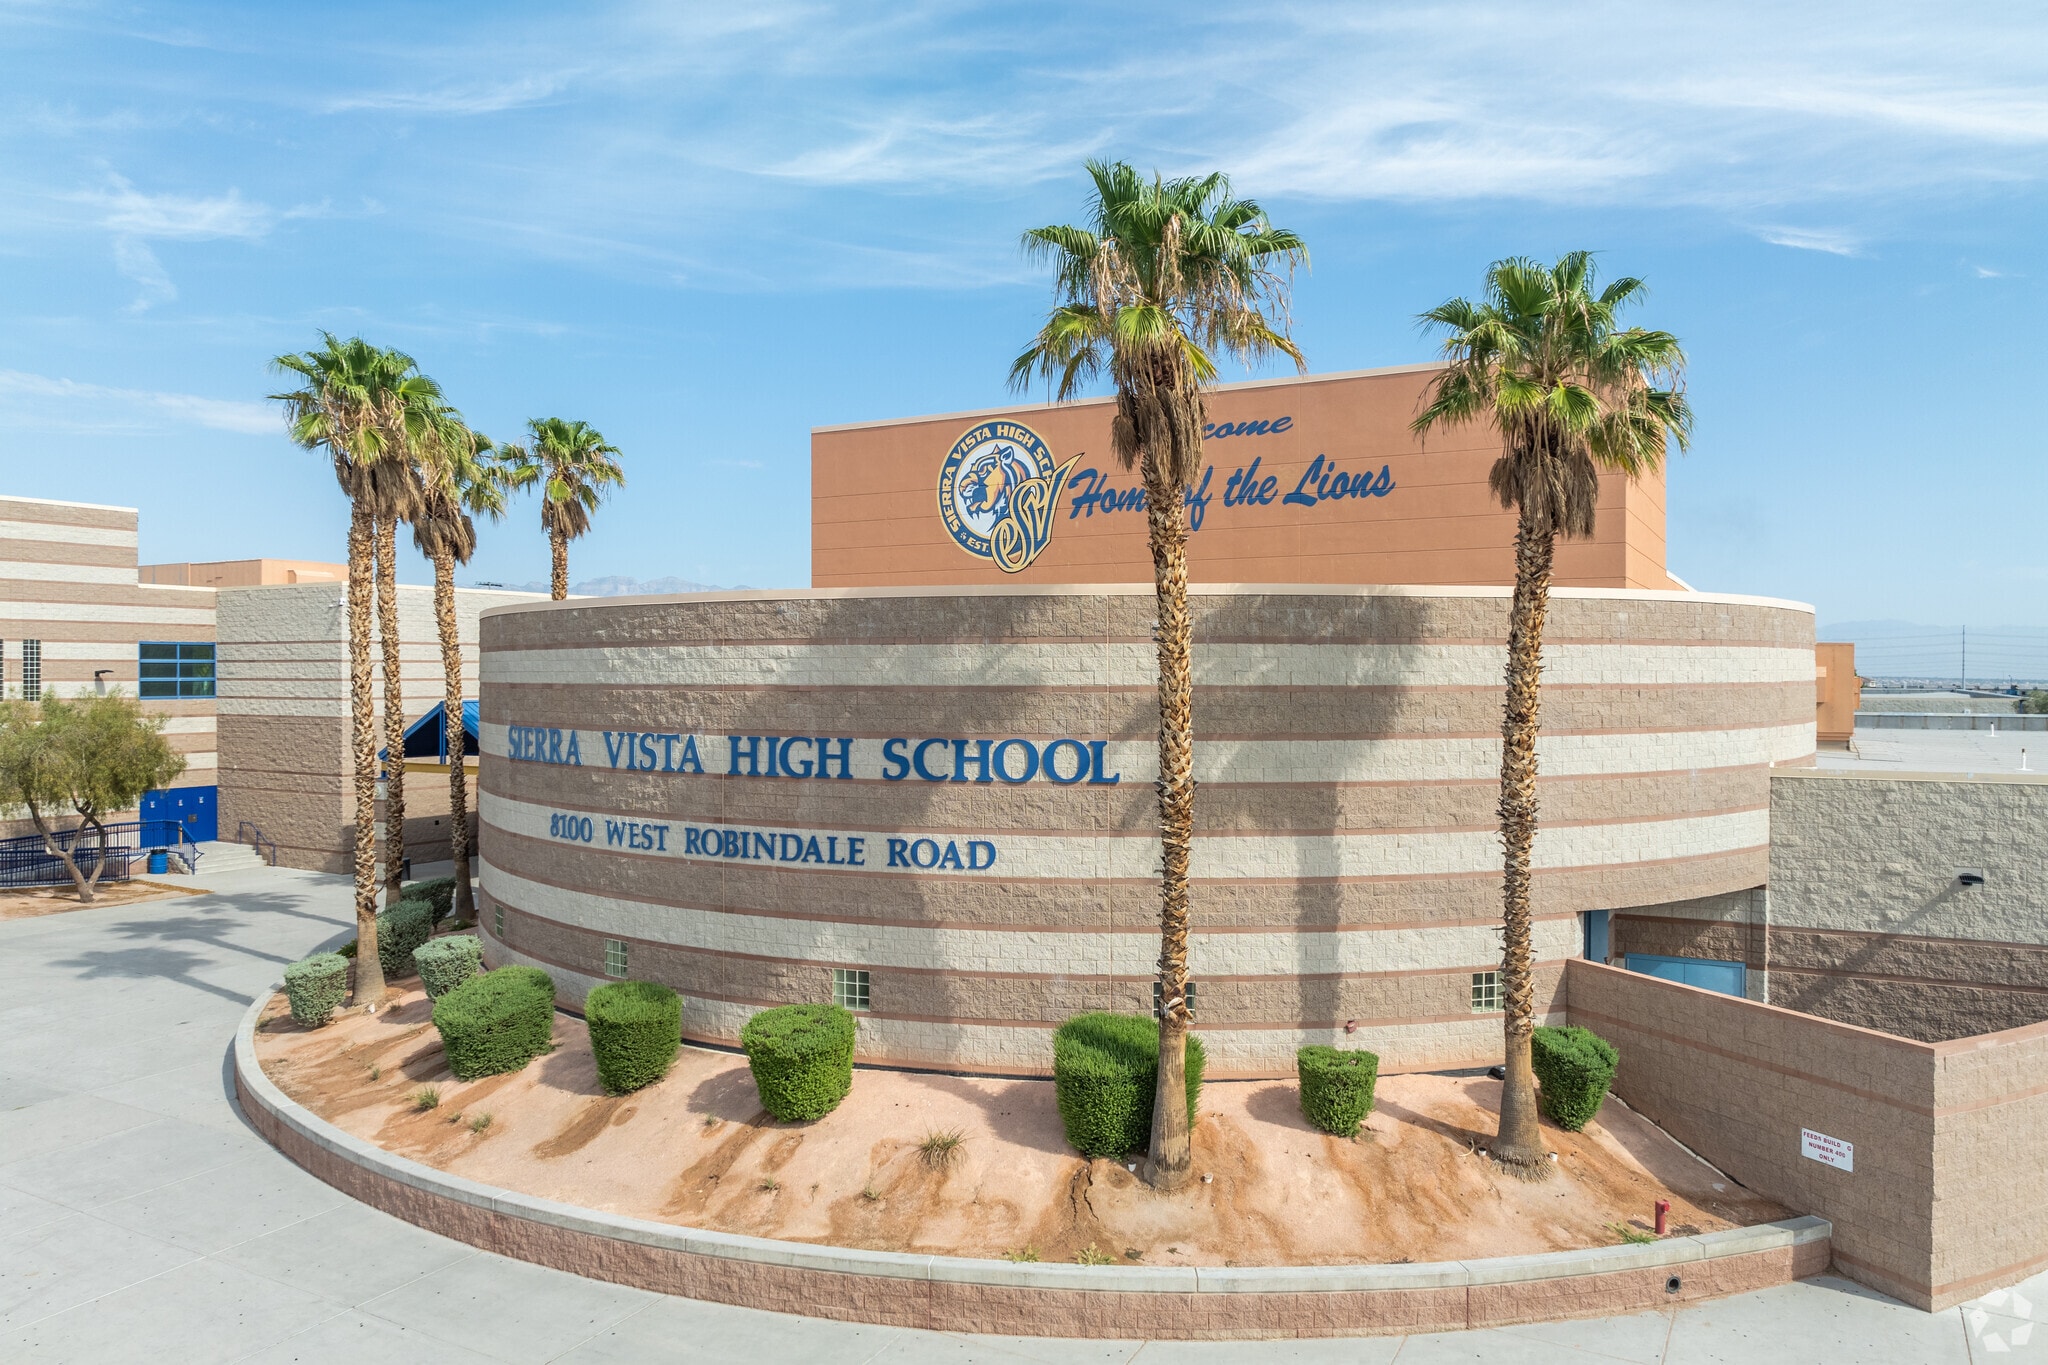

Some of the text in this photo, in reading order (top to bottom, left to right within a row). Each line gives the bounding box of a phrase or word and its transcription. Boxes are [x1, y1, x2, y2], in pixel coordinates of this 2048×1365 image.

[1203, 416, 1294, 440] come
[942, 425, 1053, 533] SIERRA VISTA HIGH SCH
[1068, 468, 1148, 519] Hom
[1223, 456, 1278, 507] the
[1283, 454, 1396, 507] Lions
[966, 538, 989, 553] EST.
[508, 725, 1121, 784] SIERRA VISTA HIGH SCHOOL
[550, 813, 997, 870] 8100 WEST ROBINDALE ROAD
[1803, 1131, 1822, 1141] FEEDS
[1808, 1142, 1834, 1154] NUMBER
[1818, 1153, 1835, 1162] ONLY
